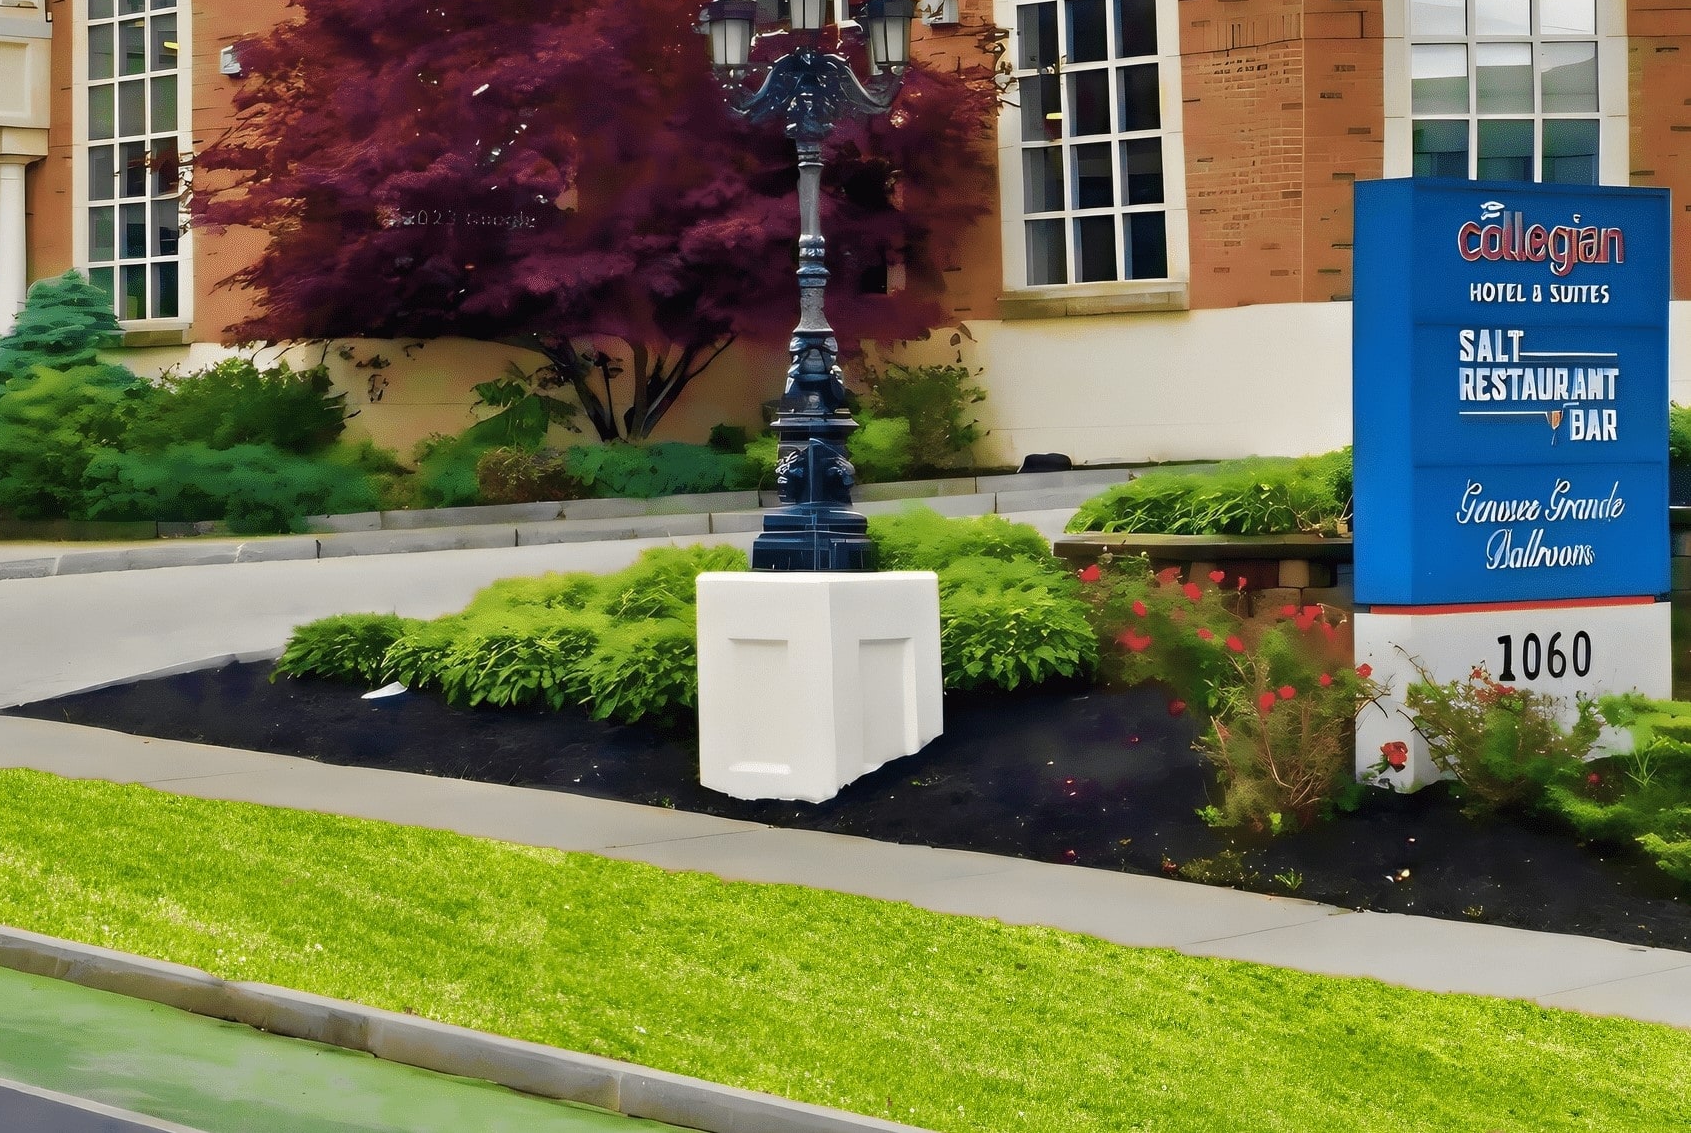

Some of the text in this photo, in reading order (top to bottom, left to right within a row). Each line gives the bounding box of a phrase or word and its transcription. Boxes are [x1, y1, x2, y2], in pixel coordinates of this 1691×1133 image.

[1458, 211, 1625, 277] collegian
[1470, 282, 1527, 303] HOTEL
[1550, 284, 1610, 304] SUITES
[1459, 329, 1524, 363] SALT
[1459, 367, 1619, 401] RESTAURANT
[1569, 409, 1618, 441] BAR
[1497, 630, 1592, 682] 1060
